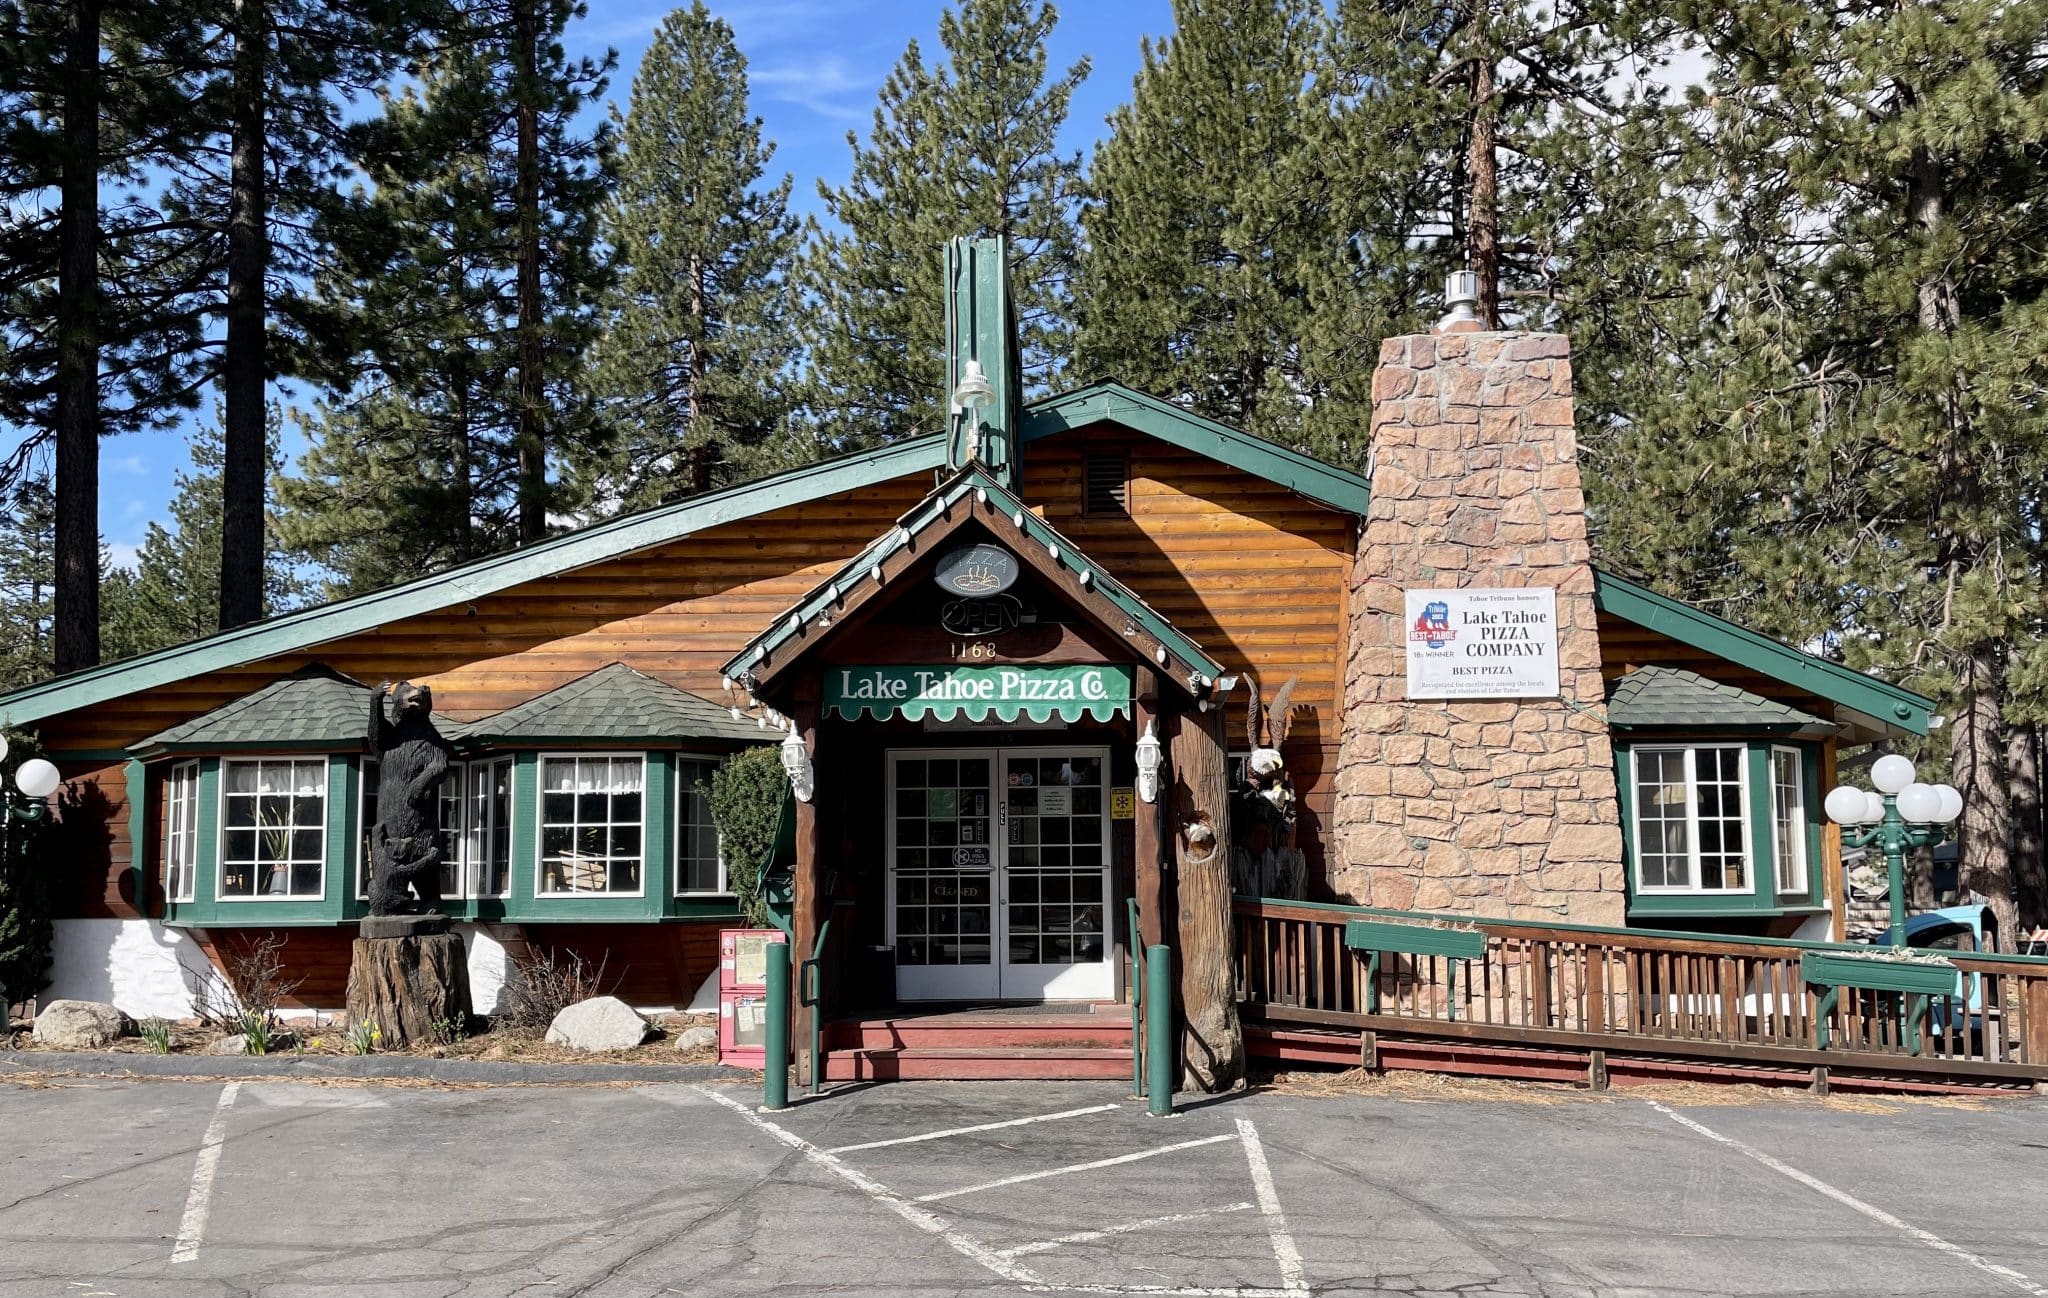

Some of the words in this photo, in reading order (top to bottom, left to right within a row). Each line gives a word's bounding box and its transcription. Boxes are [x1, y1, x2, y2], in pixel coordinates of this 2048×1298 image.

[942, 601, 1020, 628] OPEN
[1463, 611, 1498, 624] Lake
[1502, 610, 1547, 624] Tahoe
[1410, 631, 1428, 640] BEST
[1432, 631, 1455, 640] TAHOE
[1481, 627, 1530, 640] PIZZA
[950, 641, 996, 658] 1168
[1466, 643, 1545, 657] COMPANY
[1452, 666, 1479, 675] BEST
[1481, 666, 1513, 675] PIZZA
[840, 670, 907, 698] Lake
[914, 670, 994, 699] Tahoe
[1000, 671, 1076, 699] Pizza
